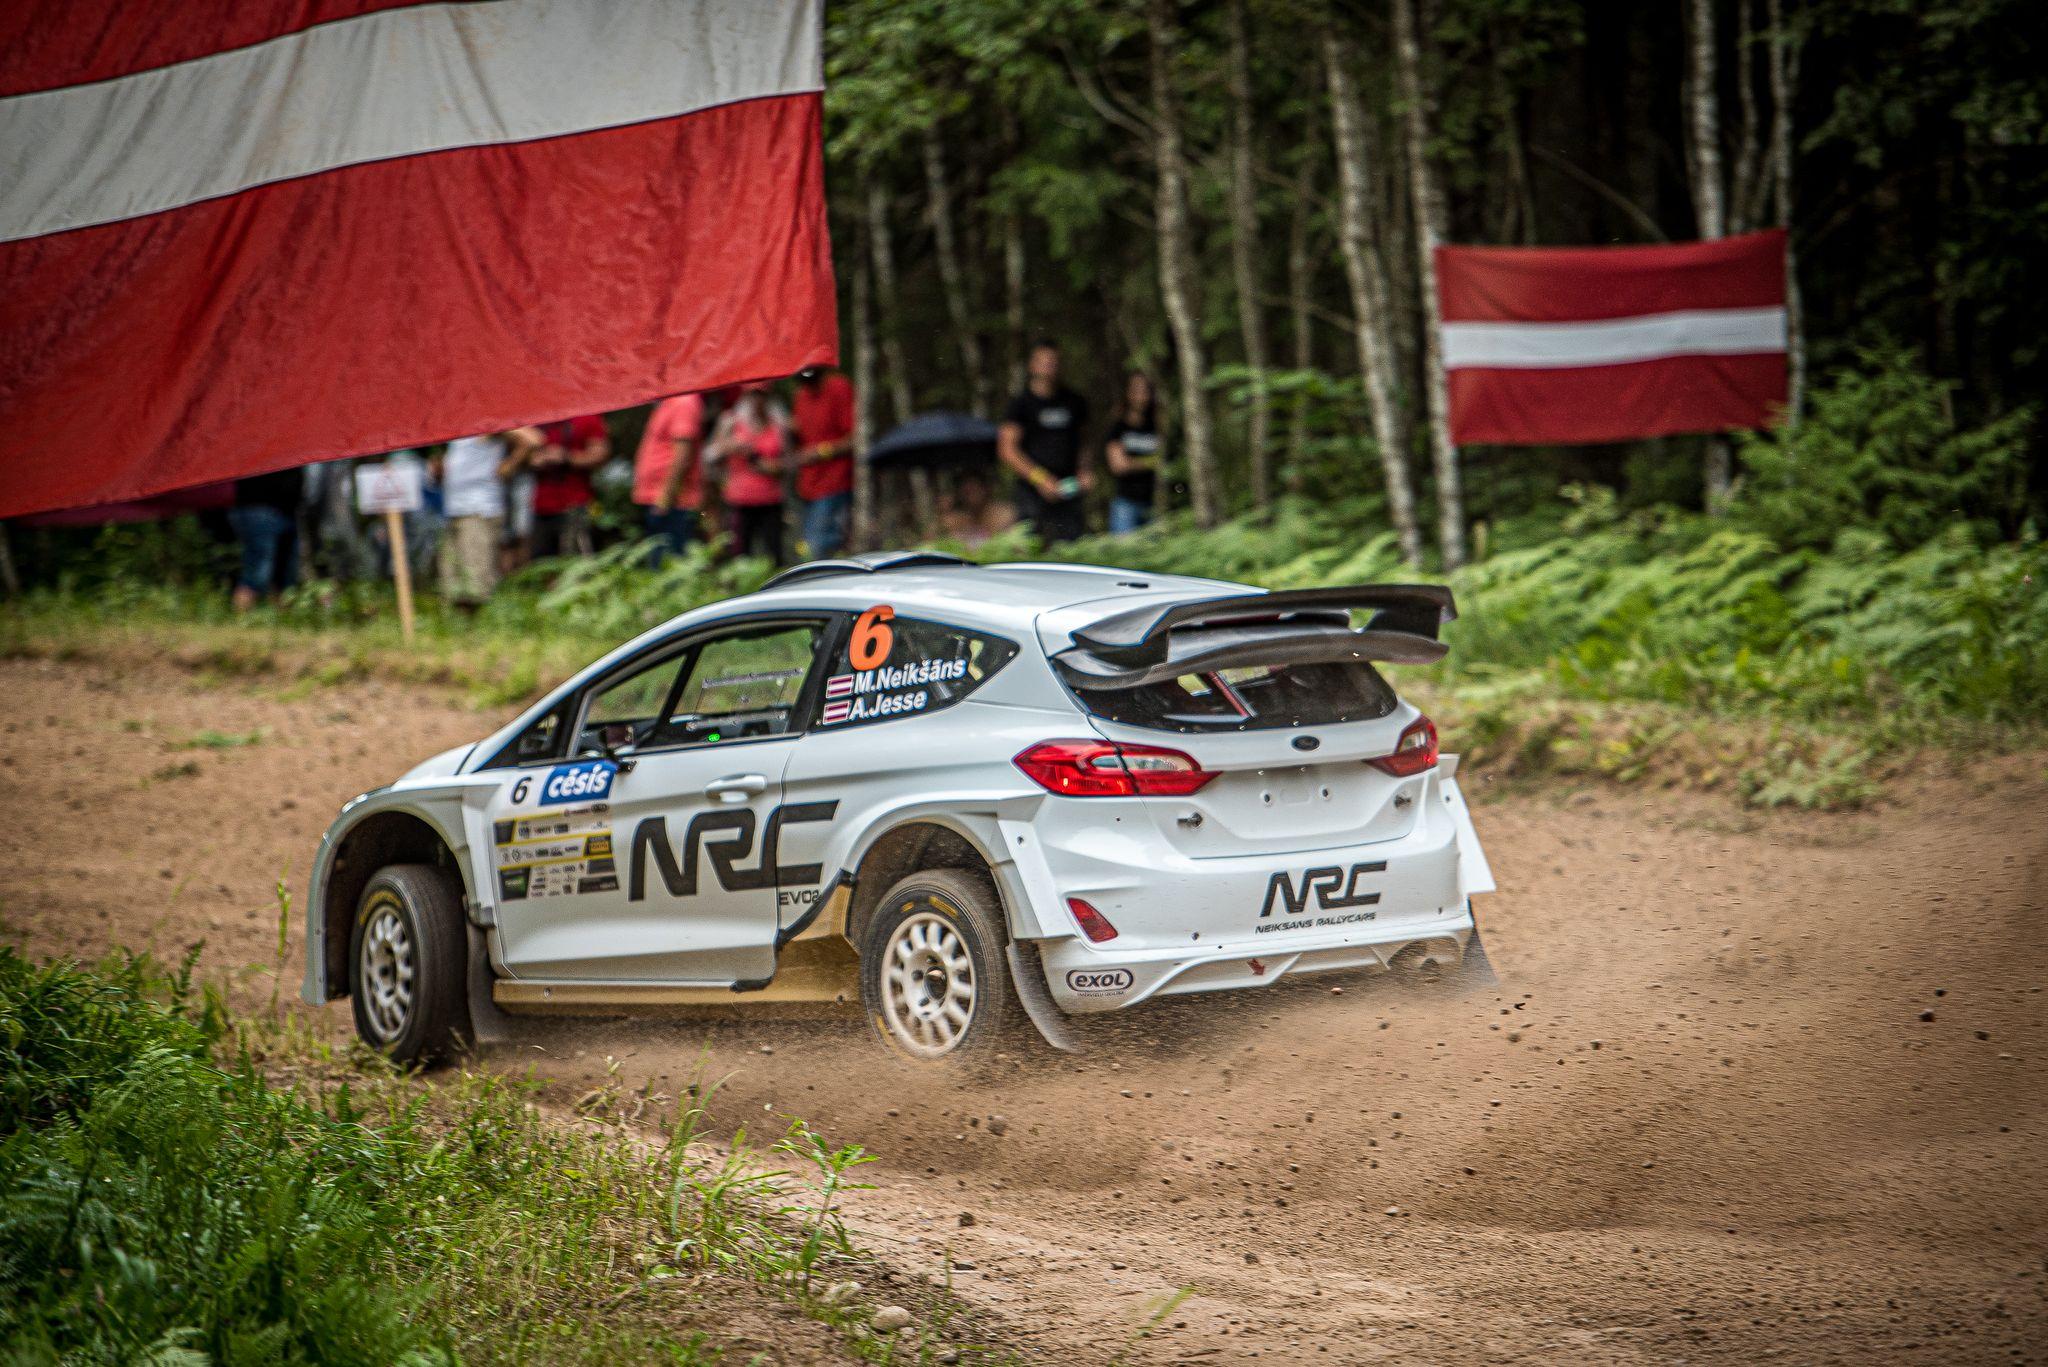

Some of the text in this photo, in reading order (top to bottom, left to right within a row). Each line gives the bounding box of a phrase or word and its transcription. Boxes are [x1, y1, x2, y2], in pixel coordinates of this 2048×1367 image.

[849, 605, 895, 671] 6
[849, 690, 928, 721] A.Jesse
[510, 776, 533, 805] 6
[628, 799, 841, 902] NRC
[1260, 861, 1388, 917] NRC
[1255, 912, 1377, 934] NEIKSANS RALLYCARS
